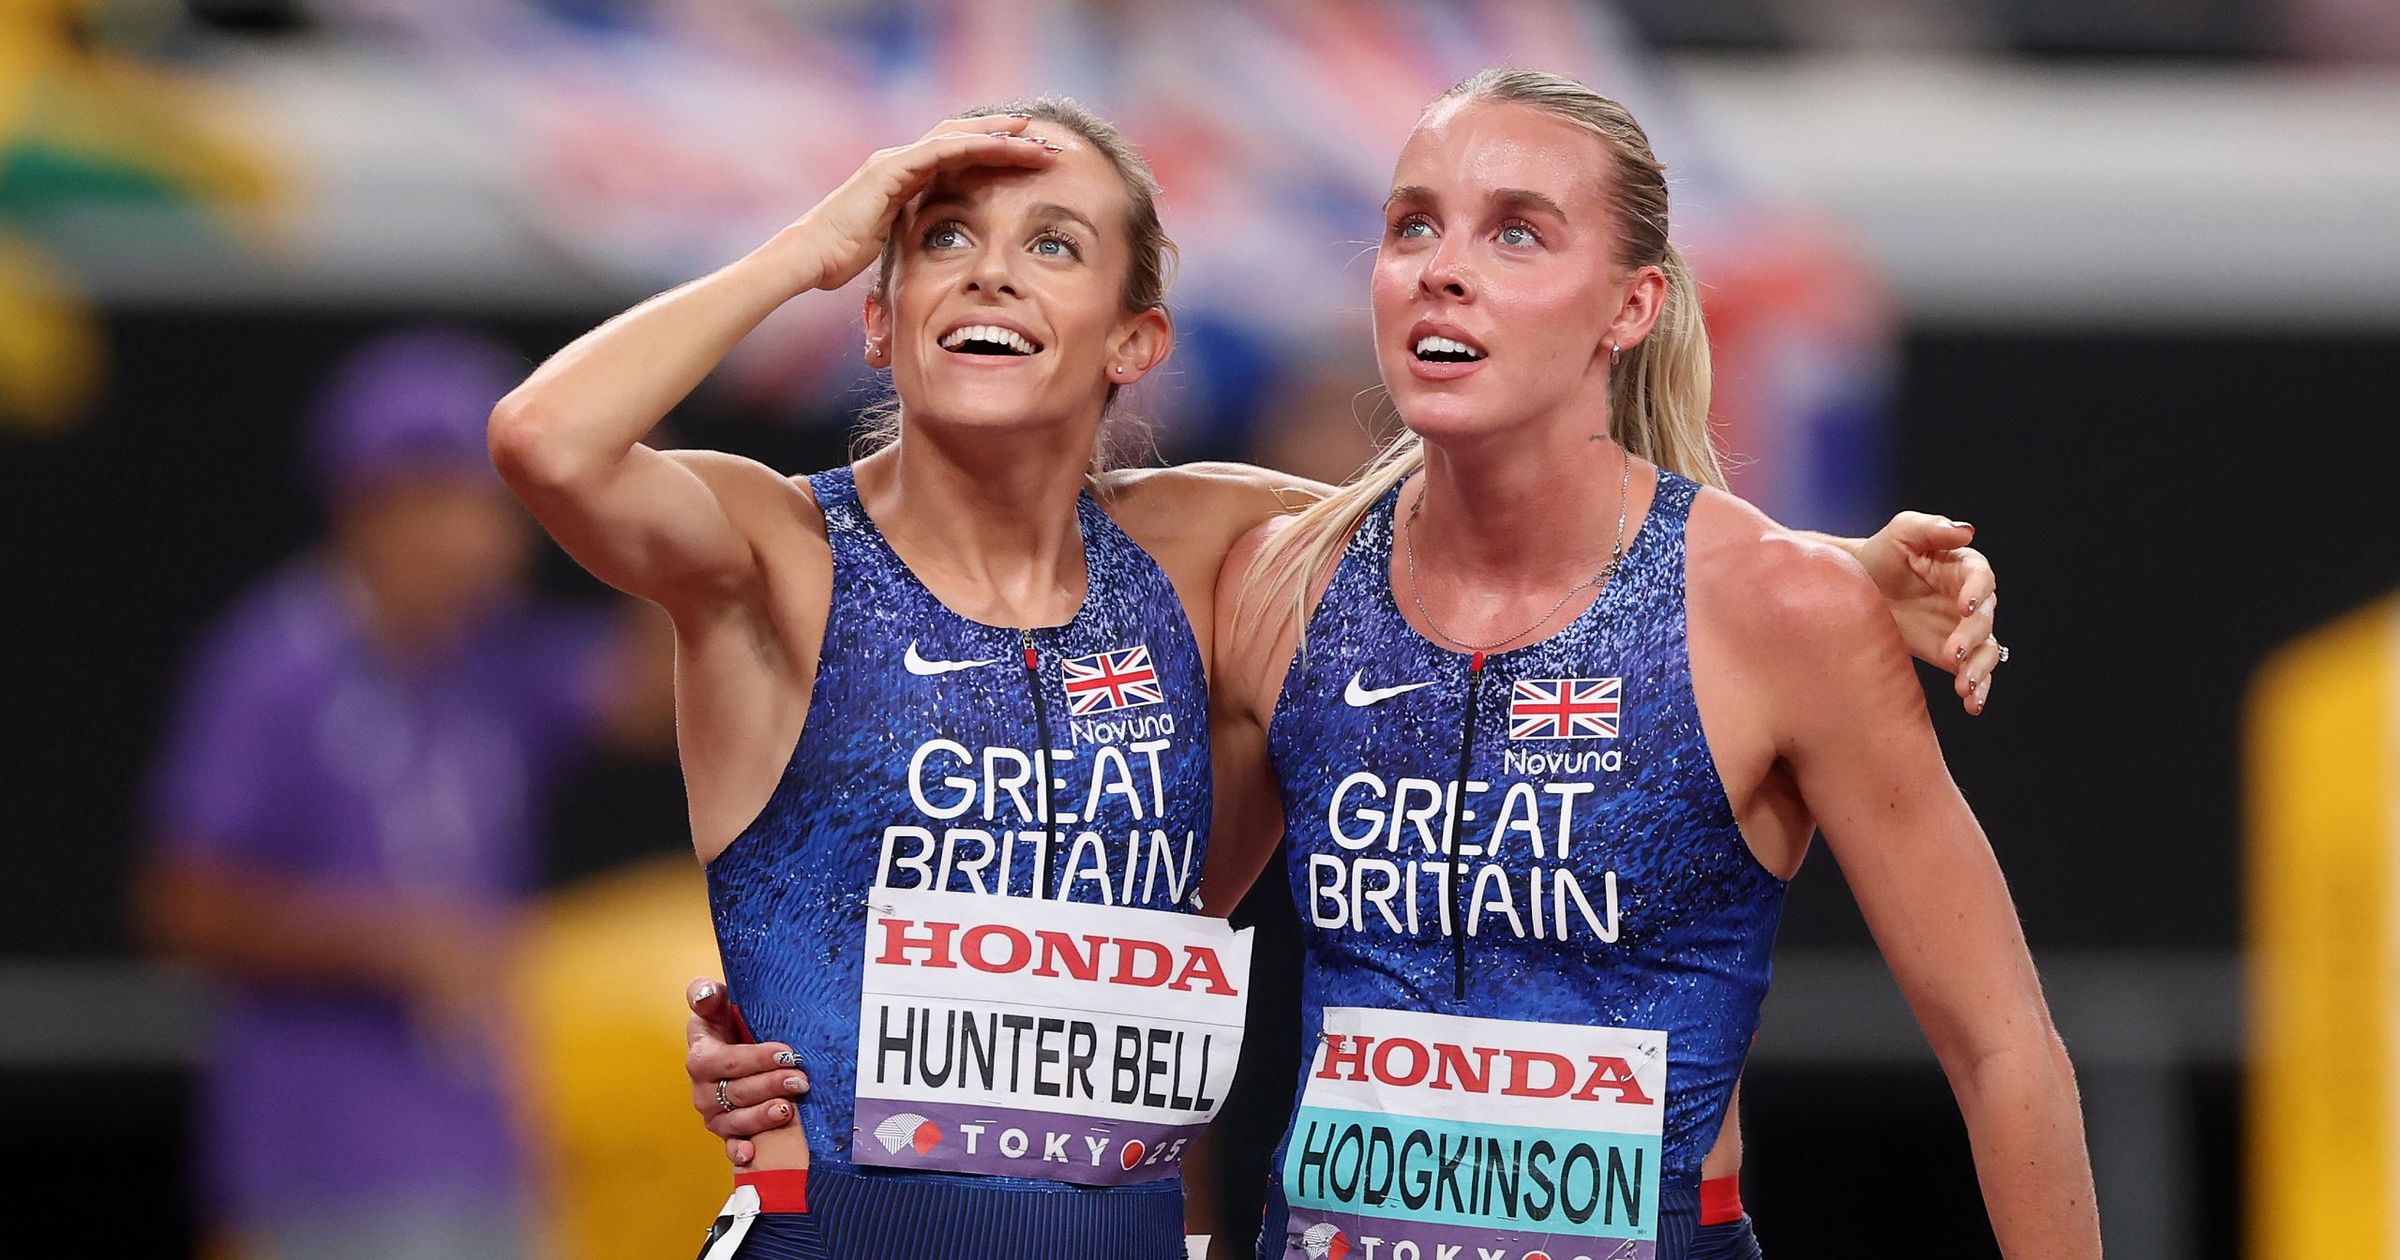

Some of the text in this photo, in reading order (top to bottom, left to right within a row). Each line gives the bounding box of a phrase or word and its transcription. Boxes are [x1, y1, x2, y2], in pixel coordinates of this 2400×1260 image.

[1070, 713, 1174, 746] Novuna
[1503, 747, 1622, 776] Novuna
[908, 738, 1171, 824] GREAT
[1328, 771, 1595, 859] GREAT
[875, 825, 1194, 906] BRITAIN
[1309, 853, 1619, 944] BRITAIN
[875, 918, 1239, 997] HONDA
[876, 1005, 1215, 1112] HUNTER BELL
[1315, 1034, 1655, 1106] HONDA
[1299, 1120, 1644, 1227] HODGKINSON
